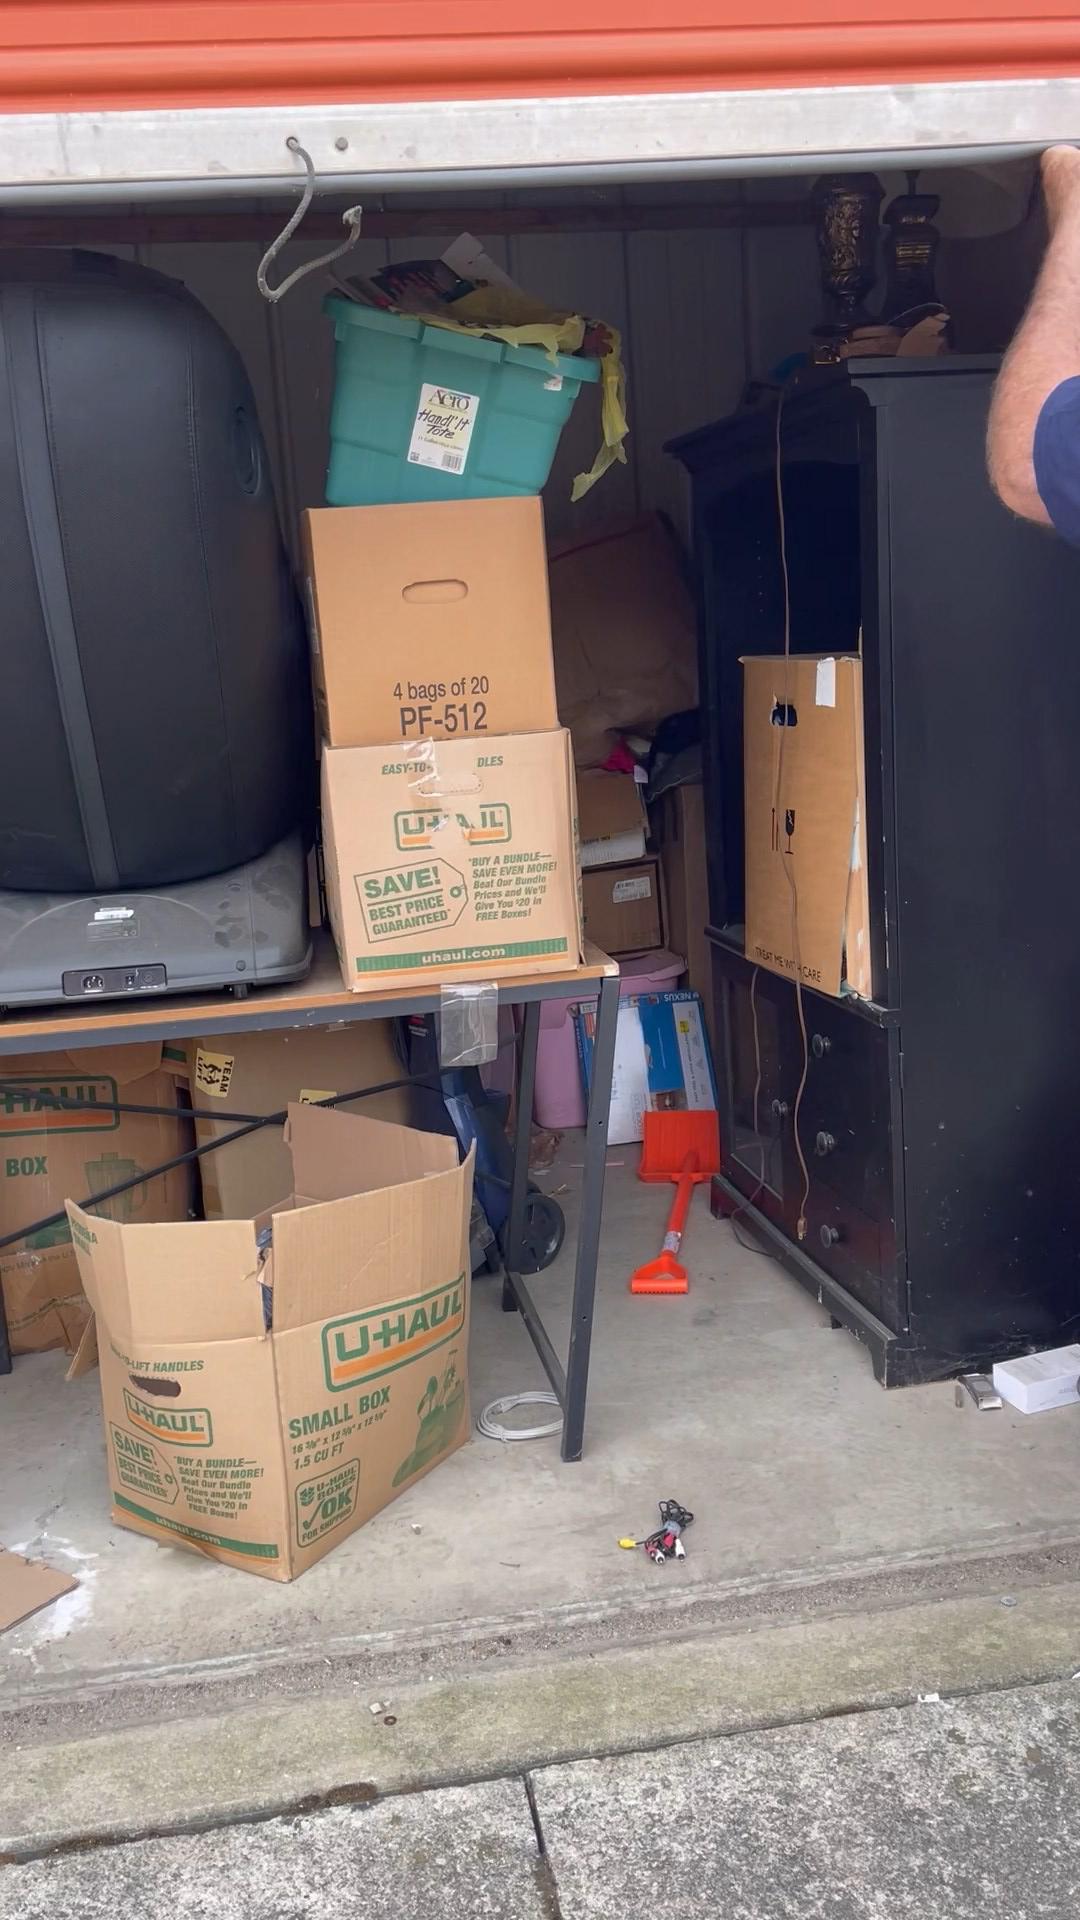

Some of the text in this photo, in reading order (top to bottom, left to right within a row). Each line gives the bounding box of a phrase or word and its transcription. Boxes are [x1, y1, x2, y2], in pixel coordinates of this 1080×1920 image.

[426, 424, 455, 439] Tote
[393, 676, 489, 703] 4 bags of 20
[400, 701, 488, 736] PF-512
[493, 856, 501, 865] A
[472, 862, 557, 879] SAVE EVEN MORE!
[364, 866, 441, 898] SAVE!
[473, 875, 546, 889] Beat Our Bundle
[474, 885, 546, 900] Prices and We'll
[369, 895, 445, 921] BEST PRICE
[475, 902, 495, 911] Give
[497, 899, 514, 908] You
[533, 897, 542, 905] in
[476, 908, 532, 921] FREE Boxes!
[422, 948, 506, 964] uhaul.com
[803, 966, 822, 983] CARE
[220, 1060, 233, 1092] TEAM
[6, 1156, 48, 1177] BOX
[335, 1290, 462, 1361] U-HAUL
[153, 1360, 204, 1372] HANDLES
[128, 1396, 204, 1432] U-HAUL
[289, 1385, 390, 1439] SMALL BOX
[292, 1443, 303, 1454] 16
[331, 1431, 340, 1441] 12
[364, 1417, 373, 1427] 12
[114, 1431, 158, 1466] SAVE!
[294, 1441, 344, 1470] 1.5 CU FT
[196, 1459, 202, 1467] A
[179, 1467, 264, 1479] SAVE EVEN MORE!
[317, 1467, 356, 1492] U-HAUL
[201, 1480, 216, 1488] Our
[219, 1481, 251, 1489] Bundle
[317, 1474, 356, 1501] BOXES
[211, 1491, 226, 1499] and
[229, 1491, 251, 1500] We'll
[321, 1486, 352, 1520] OK
[206, 1499, 220, 1507] You
[239, 1502, 247, 1510] in
[302, 1528, 318, 1543] FOR
